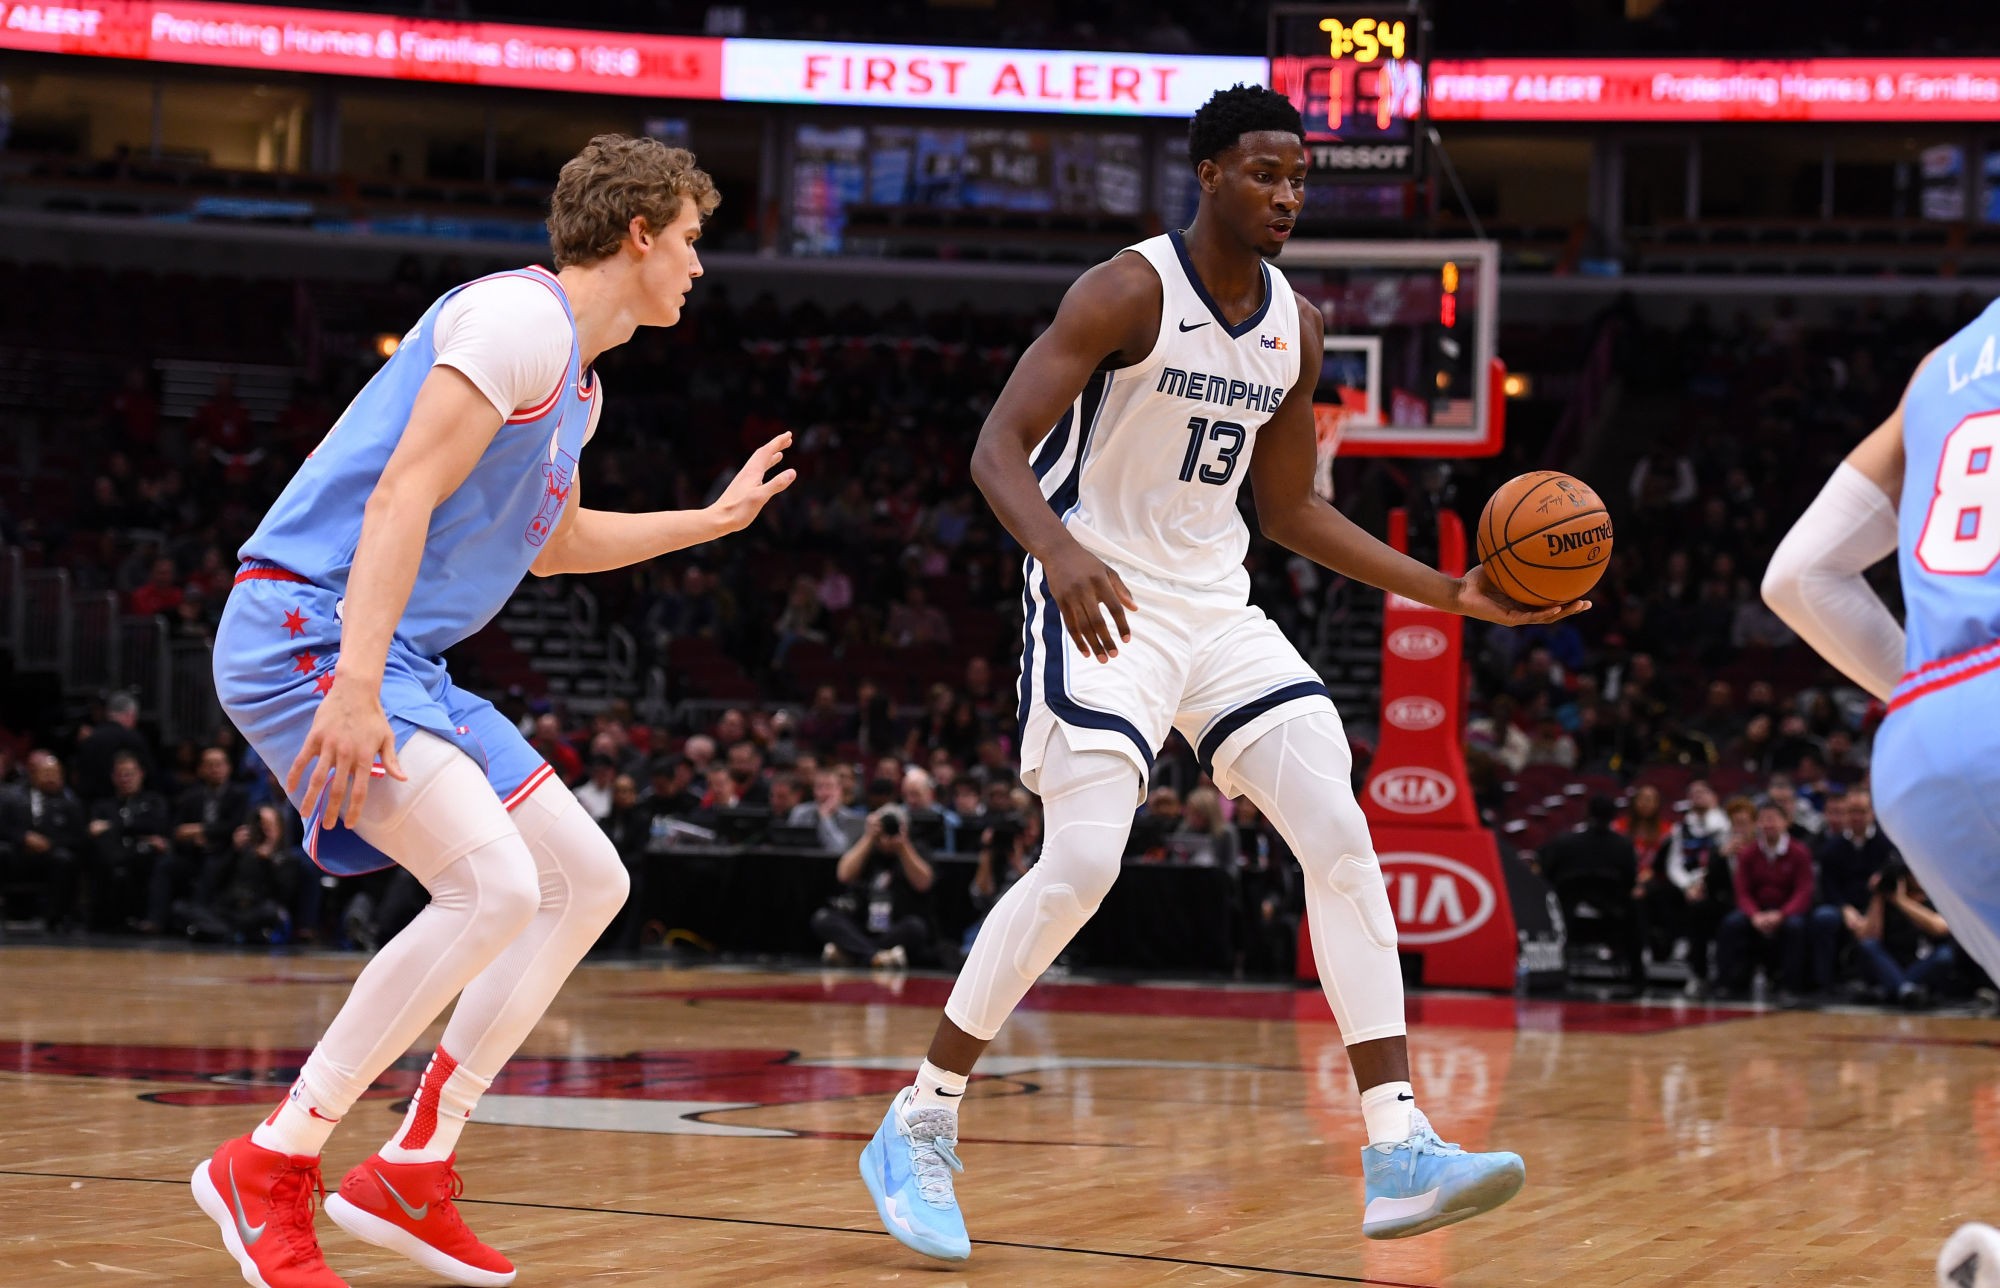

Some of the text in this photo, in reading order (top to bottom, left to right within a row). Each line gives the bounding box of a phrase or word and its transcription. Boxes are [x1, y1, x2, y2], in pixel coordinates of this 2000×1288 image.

[7, 6, 101, 36] ALERT
[1319, 18, 1405, 62] 7:54
[151, 13, 281, 56] Protecting
[284, 23, 374, 58] Homes
[376, 29, 397, 59] &
[400, 31, 501, 67] Families
[503, 38, 575, 73] Since
[803, 55, 1178, 102] FIRST ALERT
[1434, 75, 1511, 101] FIRST
[1513, 75, 1603, 101] ALERT
[1652, 73, 1778, 107] Protecting
[1781, 74, 1870, 102] Homes
[1314, 147, 1411, 169] TISSOT
[1260, 334, 1288, 351] FedEx
[1948, 334, 2000, 393] LA
[1156, 367, 1284, 413] MEMPHIS
[1178, 416, 1246, 486] 13
[1914, 409, 2000, 575] 8
[1547, 518, 1613, 557] PALDING
[1385, 778, 1442, 804] KIA
